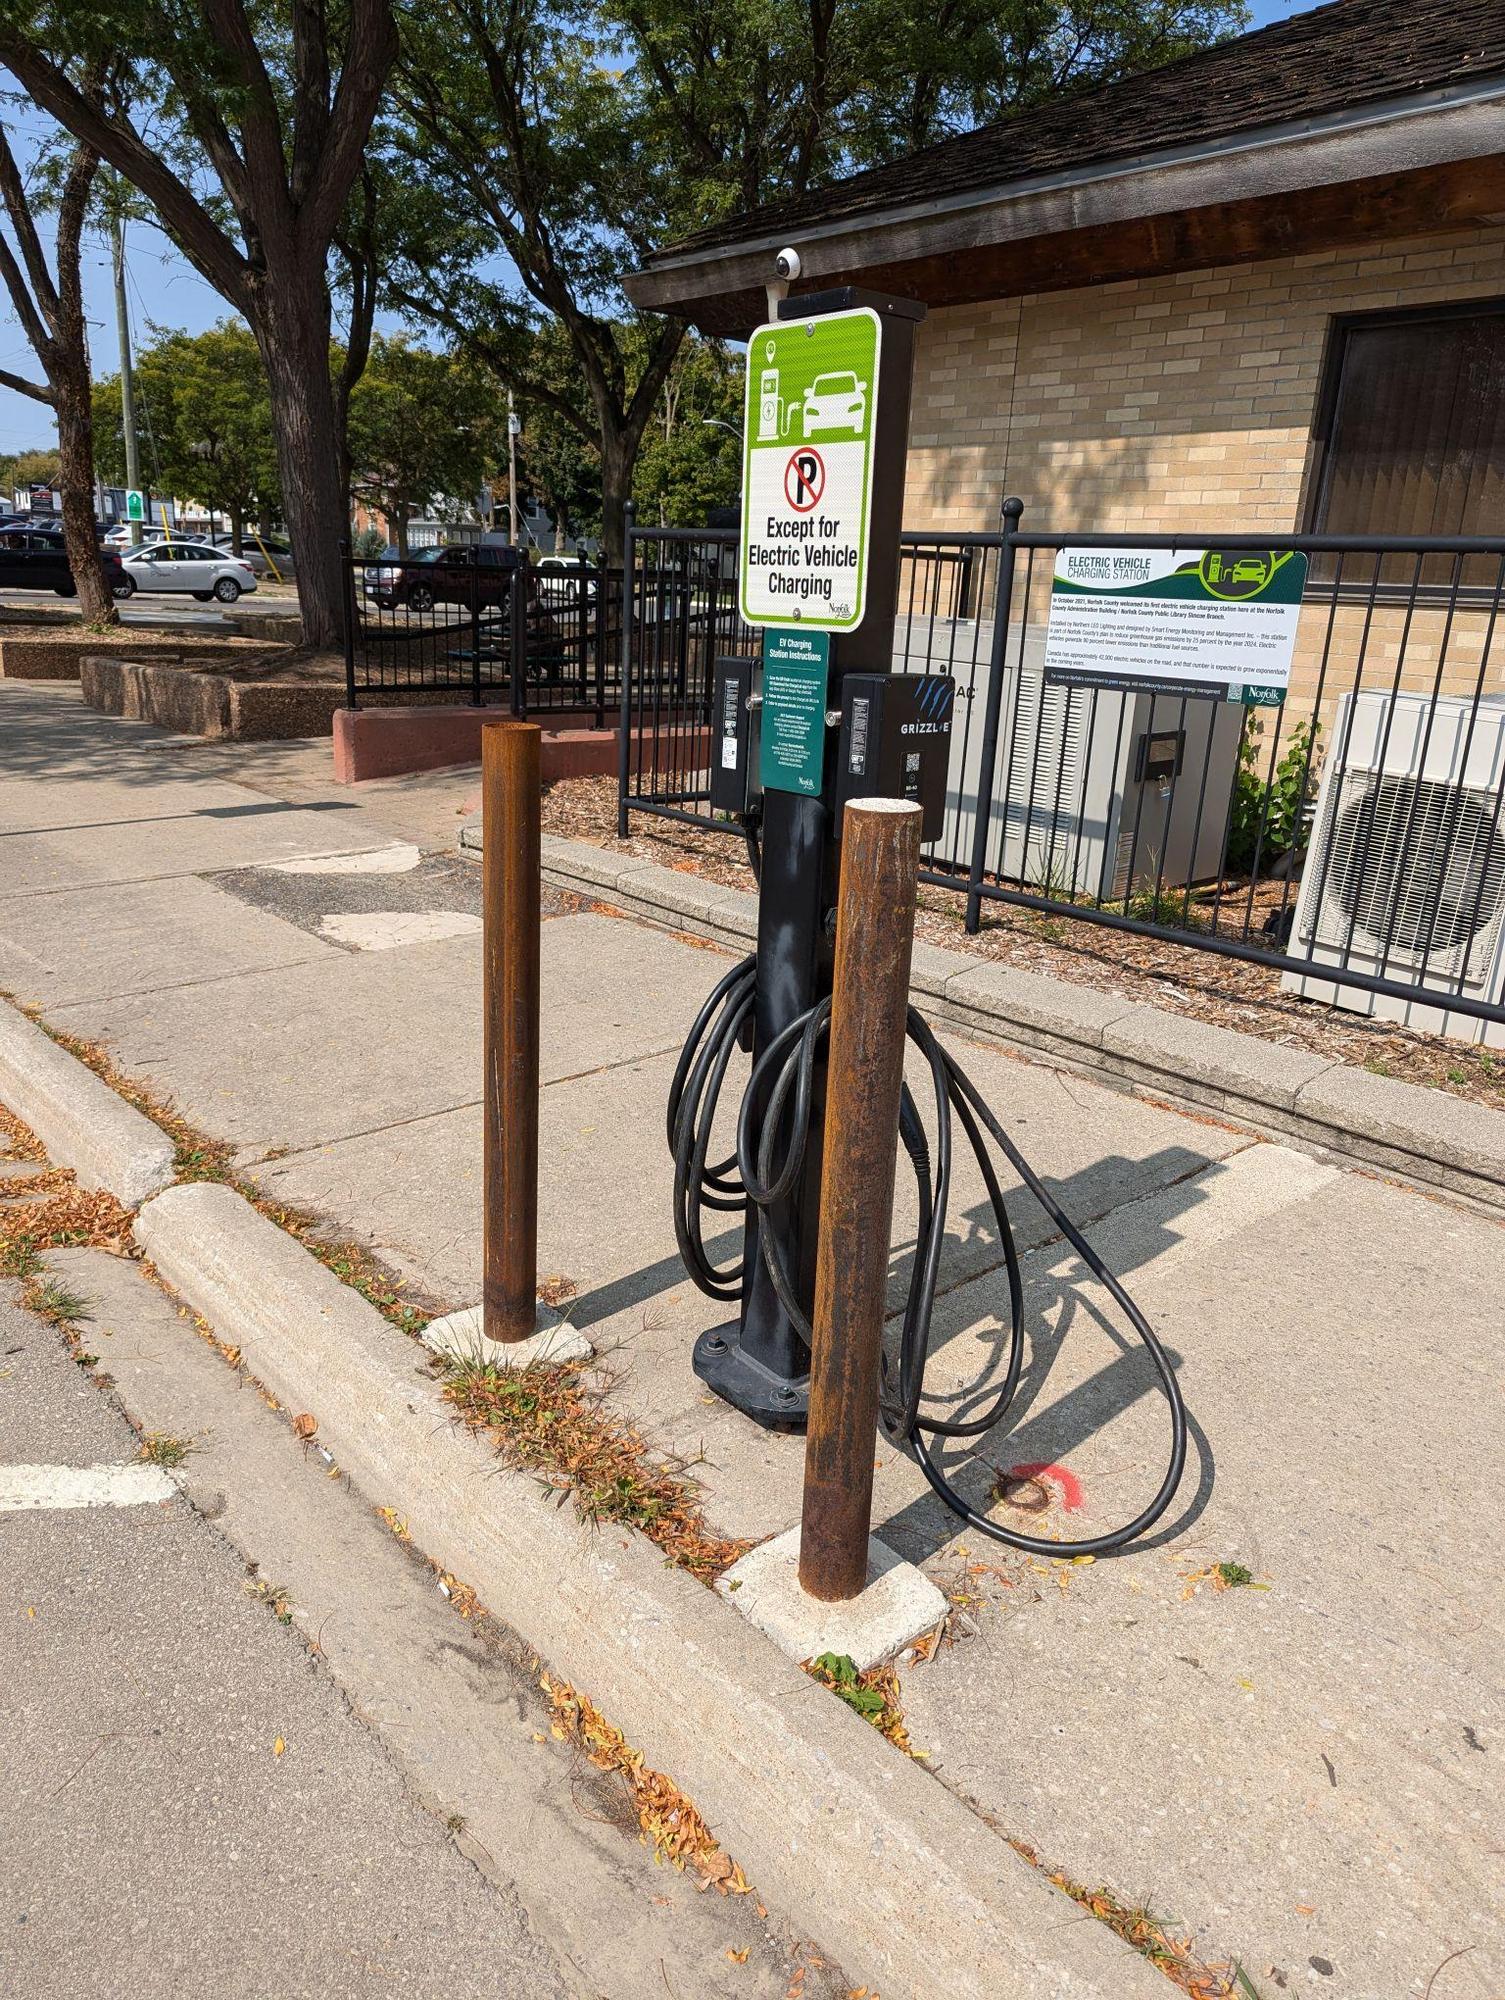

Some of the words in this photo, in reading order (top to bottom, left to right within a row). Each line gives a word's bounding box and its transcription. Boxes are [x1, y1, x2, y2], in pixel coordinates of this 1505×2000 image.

[797, 456, 817, 504] P
[766, 516, 814, 542] Except
[818, 515, 840, 538] for
[749, 544, 800, 566] Electric
[804, 545, 857, 567] Vehicle
[1068, 556, 1110, 568] ELECTRIC
[1113, 558, 1151, 569] VEHICLE
[1068, 567, 1110, 578] CHARGING
[1112, 568, 1149, 580] STATION
[768, 572, 832, 600] Charging
[828, 602, 851, 619] Norfolk
[780, 638, 786, 647] EV
[788, 639, 812, 650] Charging
[769, 649, 788, 658] Station
[789, 651, 822, 662] Instructions
[1256, 667, 1287, 676] exponentially
[1248, 686, 1280, 704] Norfolk
